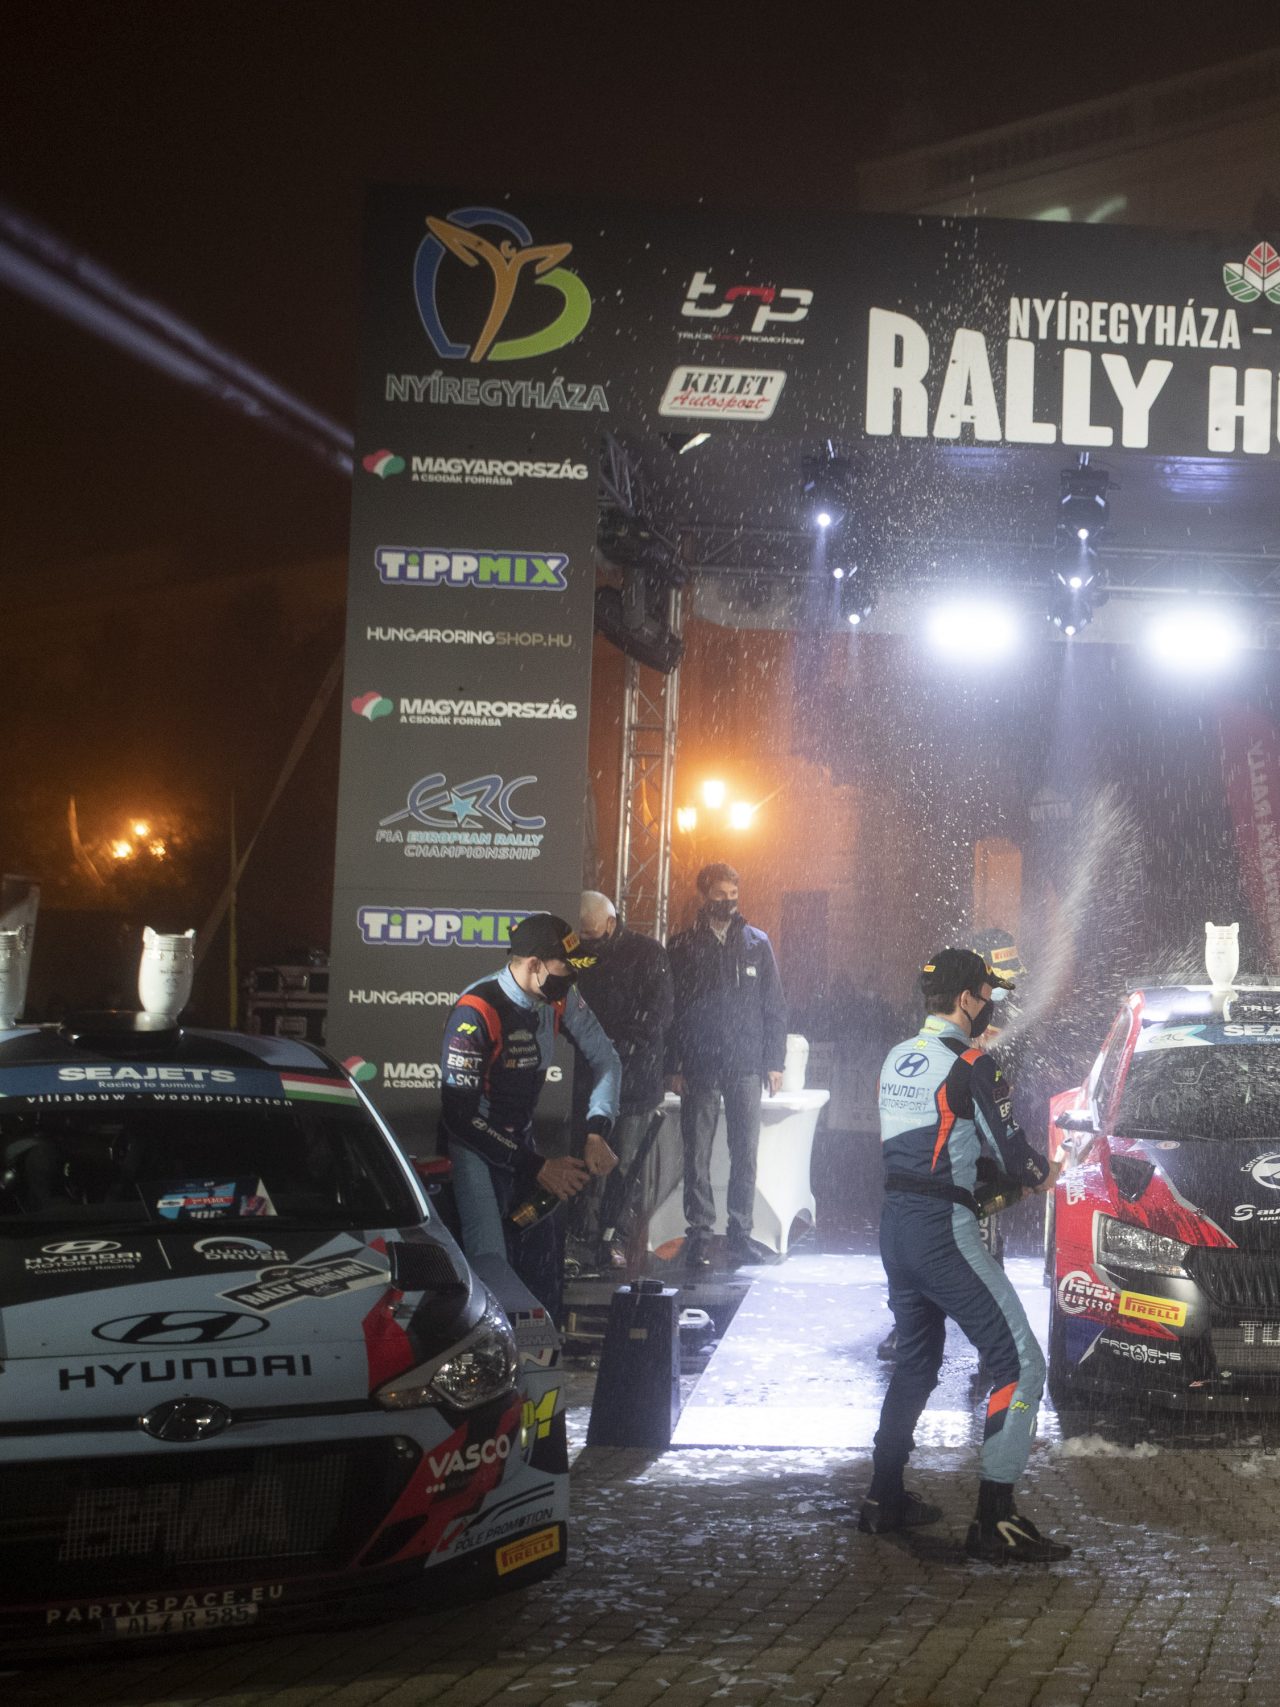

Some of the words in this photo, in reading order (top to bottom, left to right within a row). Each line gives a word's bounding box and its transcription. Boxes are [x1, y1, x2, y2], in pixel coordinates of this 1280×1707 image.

[1008, 292, 1241, 350] NYÍREGYHÁZA
[680, 373, 773, 395] KELET
[865, 306, 1174, 449] RALLY
[386, 369, 609, 413] NYÍREGYHÁZA
[670, 388, 770, 411] Autosport
[412, 455, 588, 480] MAGYARORSZÁG
[411, 473, 419, 481] A
[421, 474, 463, 483] CSODÁK
[465, 475, 513, 486] FORRÁSA
[367, 627, 572, 647] HUNGARORINGSHOP.HU
[400, 698, 577, 720] MAGYARORSZÁG
[400, 716, 407, 724] A
[409, 716, 451, 725] CSODÁK
[453, 717, 501, 727] FORRÁSA
[376, 830, 403, 842] FIA
[407, 831, 492, 845] EUROPEAN
[494, 833, 544, 846] RALLY
[404, 846, 541, 860] CHAMPIONSHIP
[364, 912, 524, 942] TiPPMI
[447, 1053, 482, 1069] EBRT
[58, 1067, 236, 1083] SEAJETS
[384, 1080, 391, 1088] A
[393, 1079, 435, 1089] CSODÁK
[456, 1074, 480, 1087] SKT
[99, 1081, 140, 1090] Racing
[881, 1083, 930, 1100] HYUNDAI
[27, 1093, 126, 1104] villabouw
[153, 1093, 294, 1108] woonprojecten
[25, 1252, 141, 1265] HYUNDAI
[205, 1249, 286, 1257] JUNIOR
[26, 1258, 140, 1270] MOTORSPORT
[237, 1283, 299, 1306] RALLY
[297, 1263, 371, 1288] HUNGARY
[1065, 1294, 1112, 1311] ELECTRO
[1125, 1297, 1180, 1321] PIRELLI
[58, 1354, 312, 1391] HYUNDAI
[428, 1434, 511, 1479] VASCO
[454, 1532, 484, 1553] POLE
[485, 1507, 554, 1543] PROMOTION
[501, 1533, 553, 1568] PIRELLI
[47, 1585, 283, 1623] PARTYSPACE.EU
